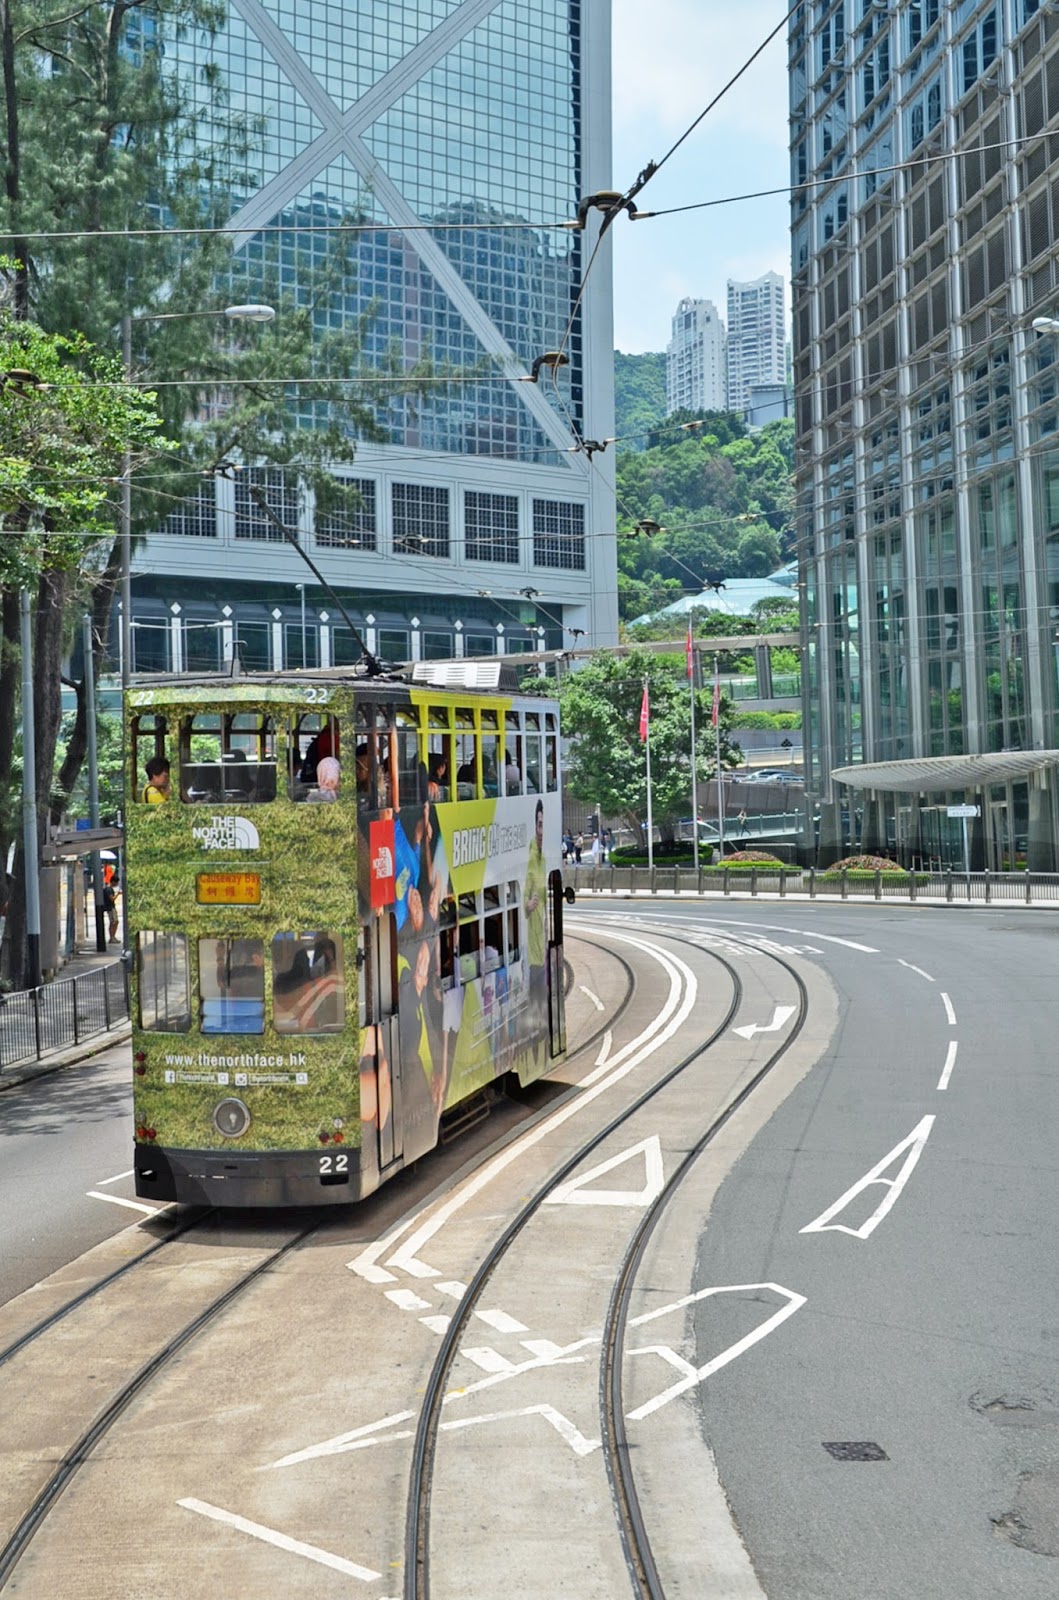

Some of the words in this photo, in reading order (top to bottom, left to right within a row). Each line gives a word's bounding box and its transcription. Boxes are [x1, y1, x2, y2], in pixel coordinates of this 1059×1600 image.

[135, 691, 154, 706] 22
[304, 688, 328, 704] 22
[211, 816, 235, 828] THE
[192, 827, 235, 839] NORTH
[203, 839, 235, 850] FACE
[452, 825, 486, 869] BRING
[200, 873, 241, 885] Causeway
[245, 873, 261, 885] Bay
[165, 1053, 306, 1067] www.thenorthface.hk
[319, 1154, 349, 1174] 22
